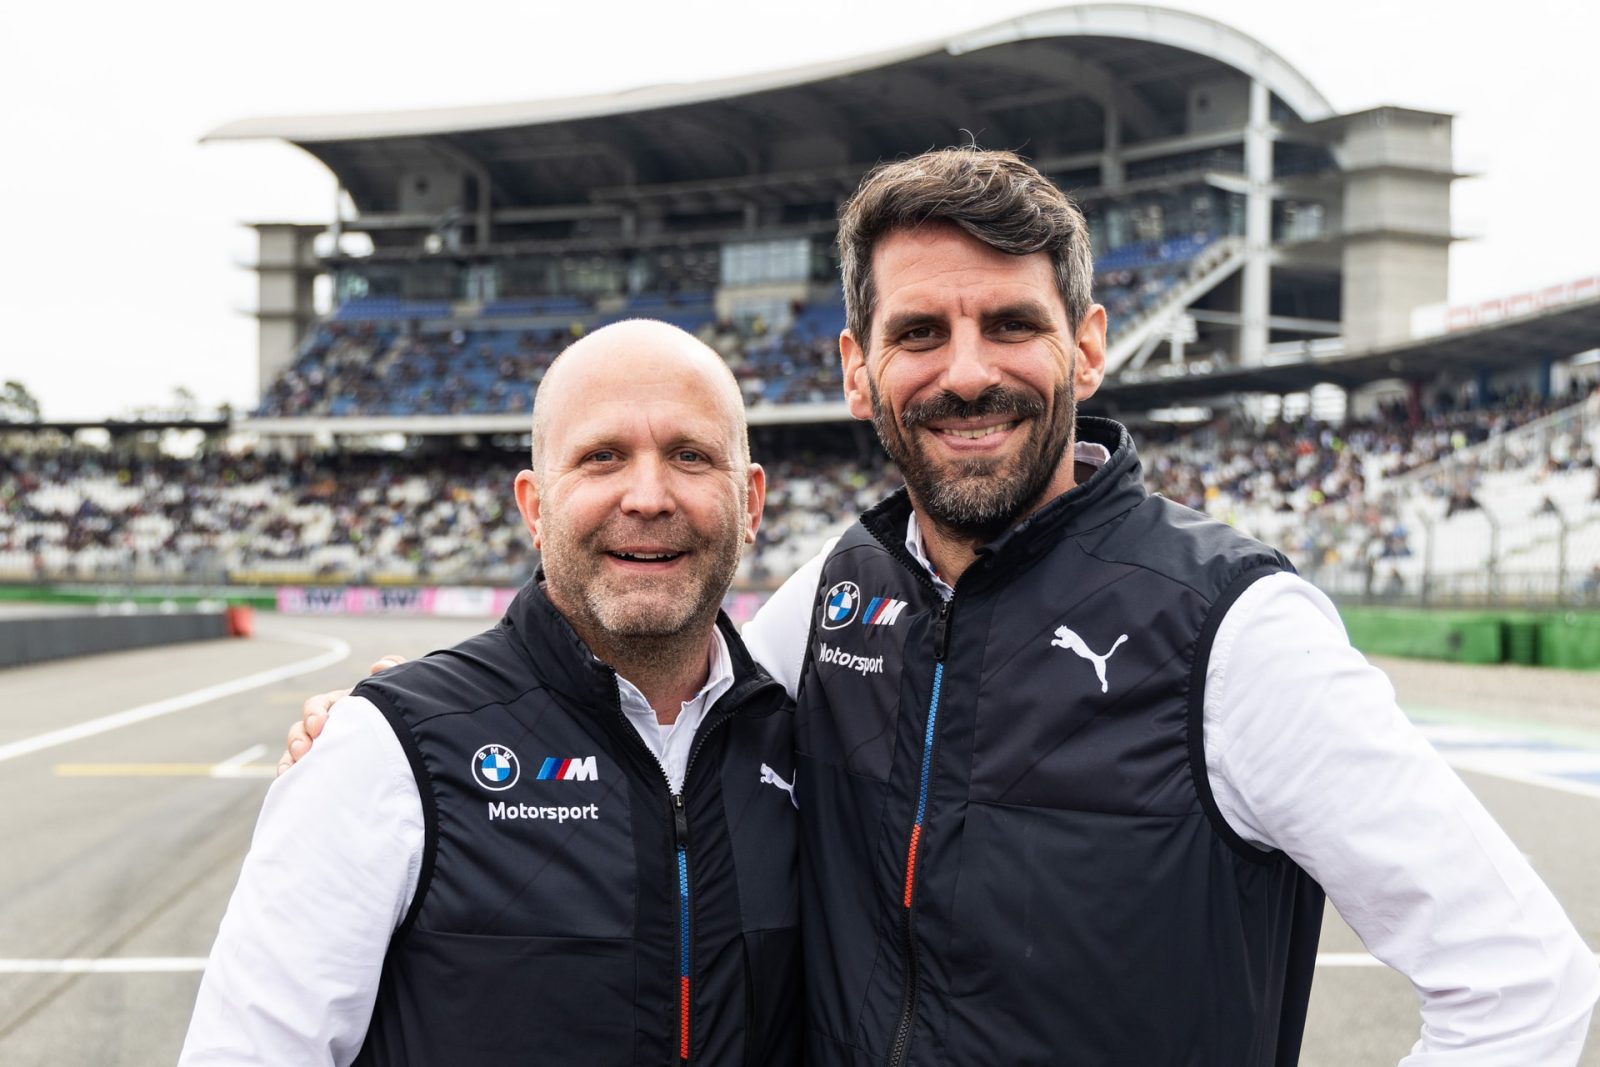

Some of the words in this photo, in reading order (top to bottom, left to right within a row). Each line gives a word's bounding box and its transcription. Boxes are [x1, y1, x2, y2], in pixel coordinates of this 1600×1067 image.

[831, 584, 858, 600] BMW
[874, 598, 908, 626] M
[819, 642, 884, 677] Motorsport
[478, 747, 512, 760] BMW
[563, 755, 599, 781] M
[488, 801, 599, 824] Motorsport
